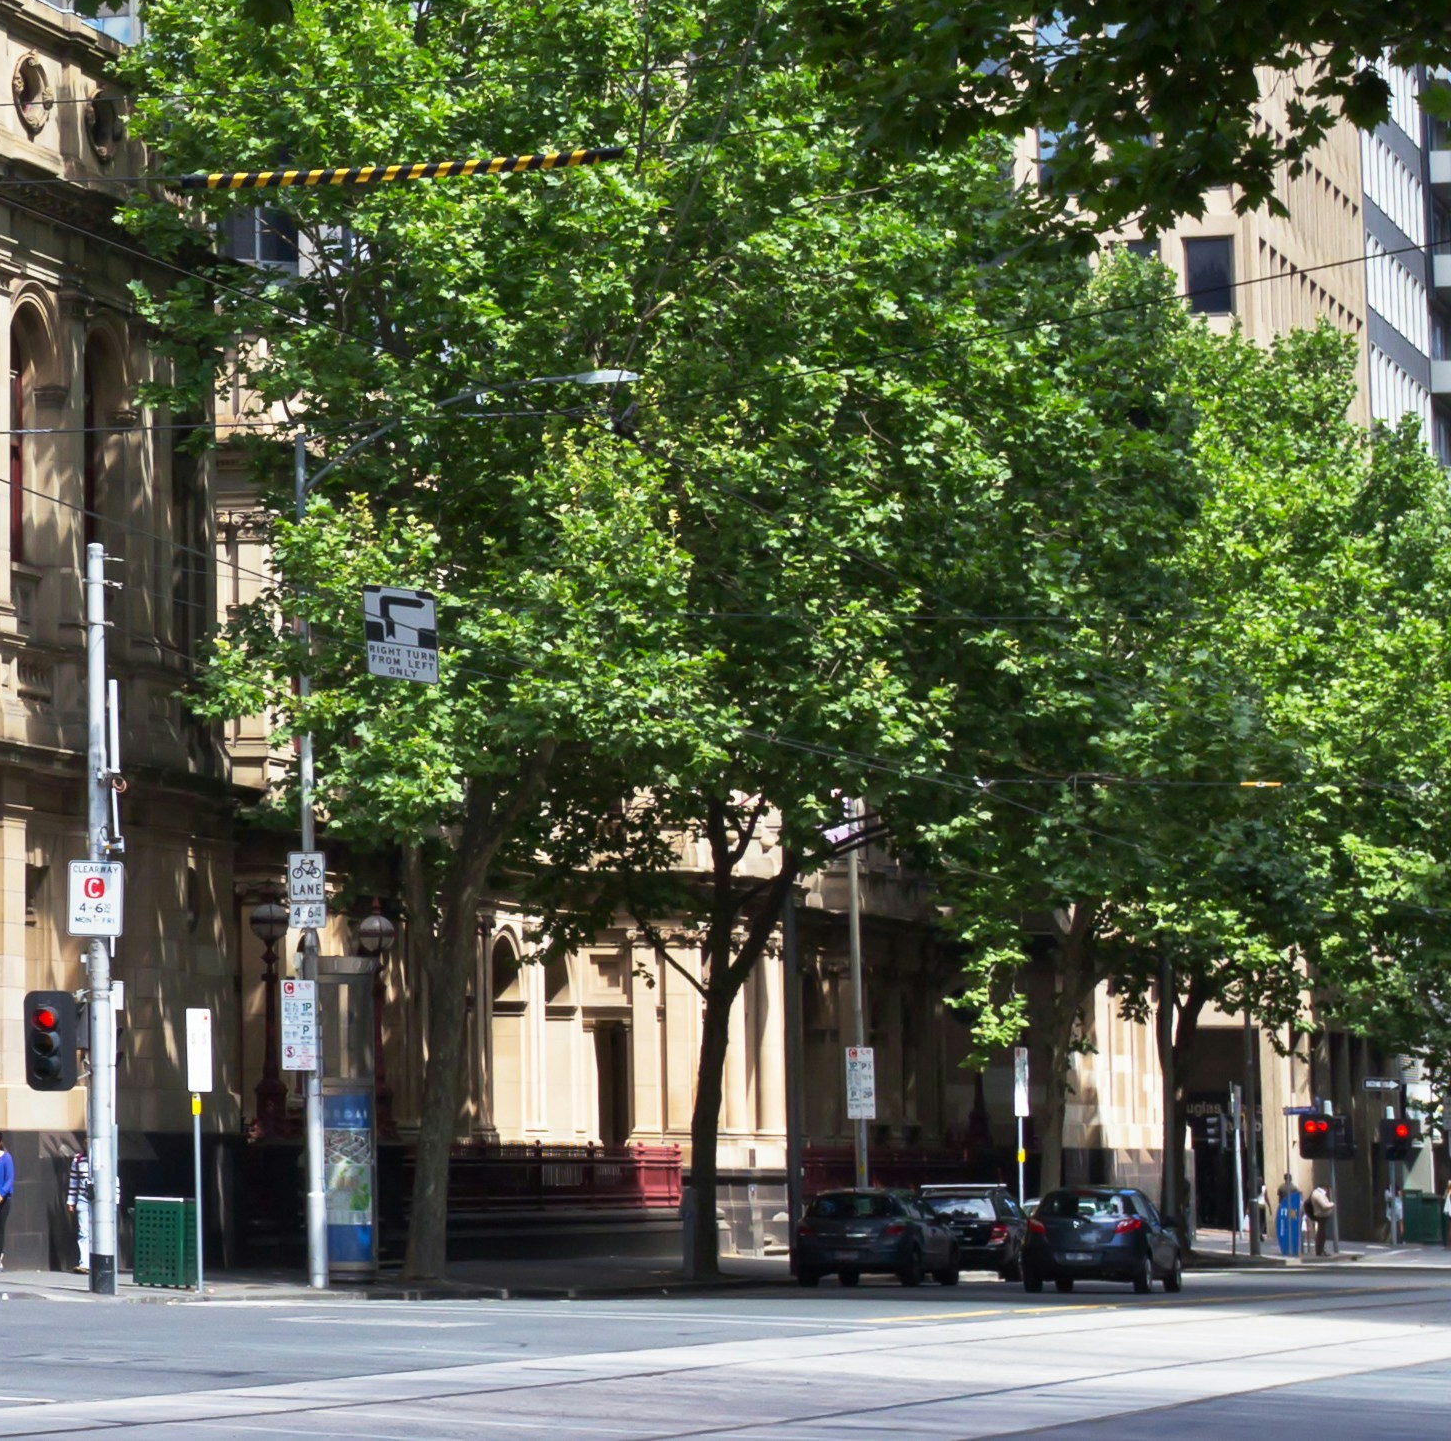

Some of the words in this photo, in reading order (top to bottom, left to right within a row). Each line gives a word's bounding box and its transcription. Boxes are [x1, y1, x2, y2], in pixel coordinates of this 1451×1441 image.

[369, 645, 401, 656] RIGHT
[406, 649, 435, 661] TURN
[371, 654, 401, 665] FROM
[408, 659, 433, 671] LEFT
[388, 666, 417, 678] ONLY
[72, 865, 118, 873] CLEARWAY
[292, 883, 322, 896] LANE
[302, 1002, 312, 1012] 1P
[302, 1024, 310, 1035] P
